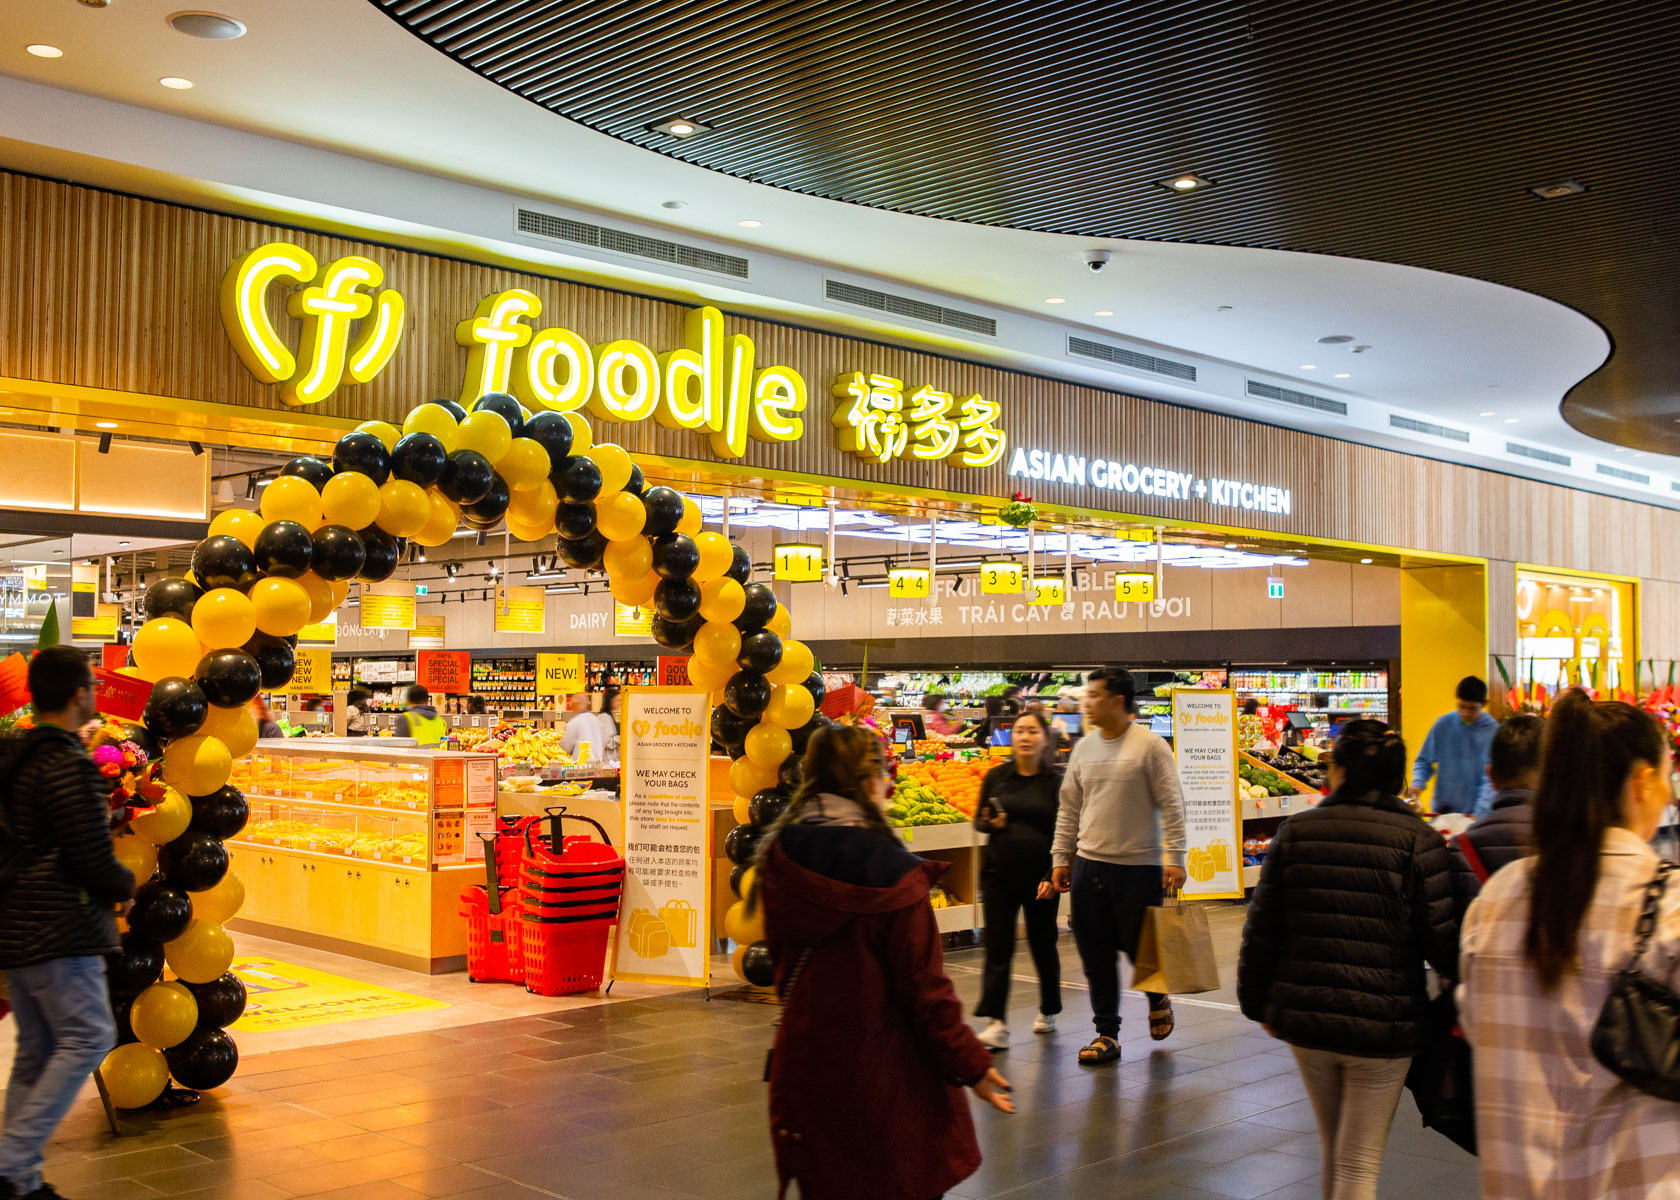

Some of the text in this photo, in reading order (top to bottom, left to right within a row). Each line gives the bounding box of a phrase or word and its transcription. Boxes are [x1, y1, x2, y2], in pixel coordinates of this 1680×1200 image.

[456, 288, 808, 458] foodle
[836, 371, 1006, 468] 福多多
[1008, 447, 1290, 515] ASIAN GROCERY + KITCHEN
[783, 554, 789, 571] 1
[806, 554, 812, 571] 1
[896, 576, 904, 590] 4
[915, 576, 924, 590] 4
[989, 570, 997, 585] 3
[1010, 570, 1017, 585] 3
[365, 583, 371, 592] 3
[1052, 584, 1059, 598] 6
[1123, 581, 1131, 595] 5
[1142, 581, 1149, 595] 5
[958, 600, 1005, 624] TRÁI
[1082, 601, 1127, 620] RAU
[570, 612, 608, 629] DAIRY
[428, 659, 459, 667] SPECIAL
[666, 665, 688, 674] GOO
[428, 667, 459, 675] SPECIAL
[545, 668, 577, 680] NEW!
[428, 675, 459, 683] SPECIAL
[643, 707, 692, 715] WELCOME TO
[1195, 711, 1229, 726] foodle
[654, 718, 703, 739] foodle
[636, 769, 697, 779] WE MAY CHECK
[644, 779, 689, 788] YOUR BAGS
